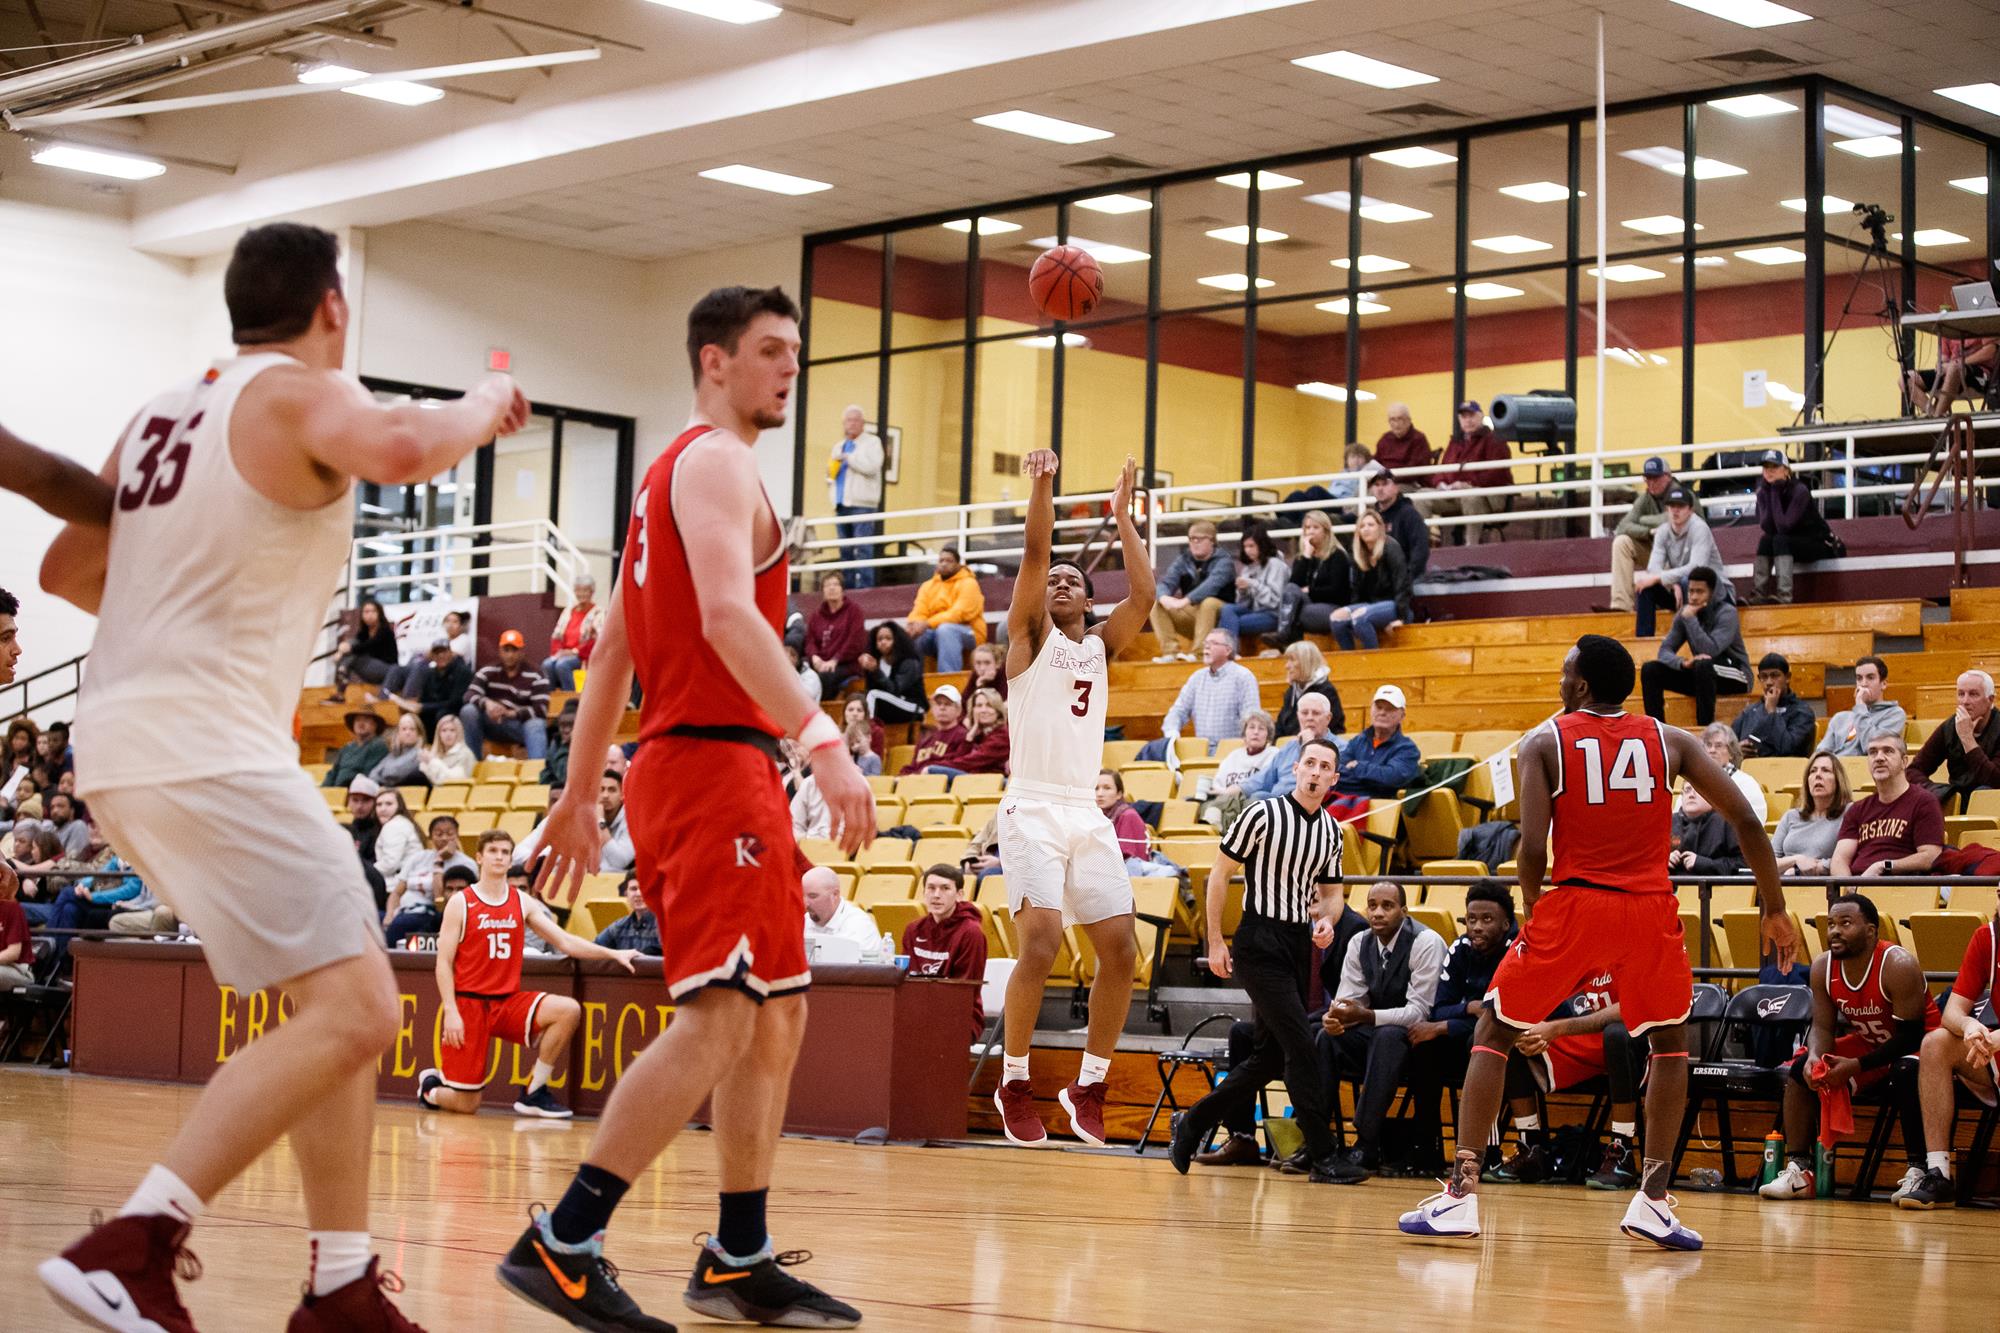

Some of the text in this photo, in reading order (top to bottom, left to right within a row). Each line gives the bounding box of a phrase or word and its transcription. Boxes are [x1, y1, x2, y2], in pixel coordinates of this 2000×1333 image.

[1071, 679, 1093, 718] 3
[1575, 737, 1656, 804] 14
[487, 932, 512, 960] 15
[1837, 998, 1883, 1017] Tornado
[1693, 1067, 1729, 1076] ERSKINE
